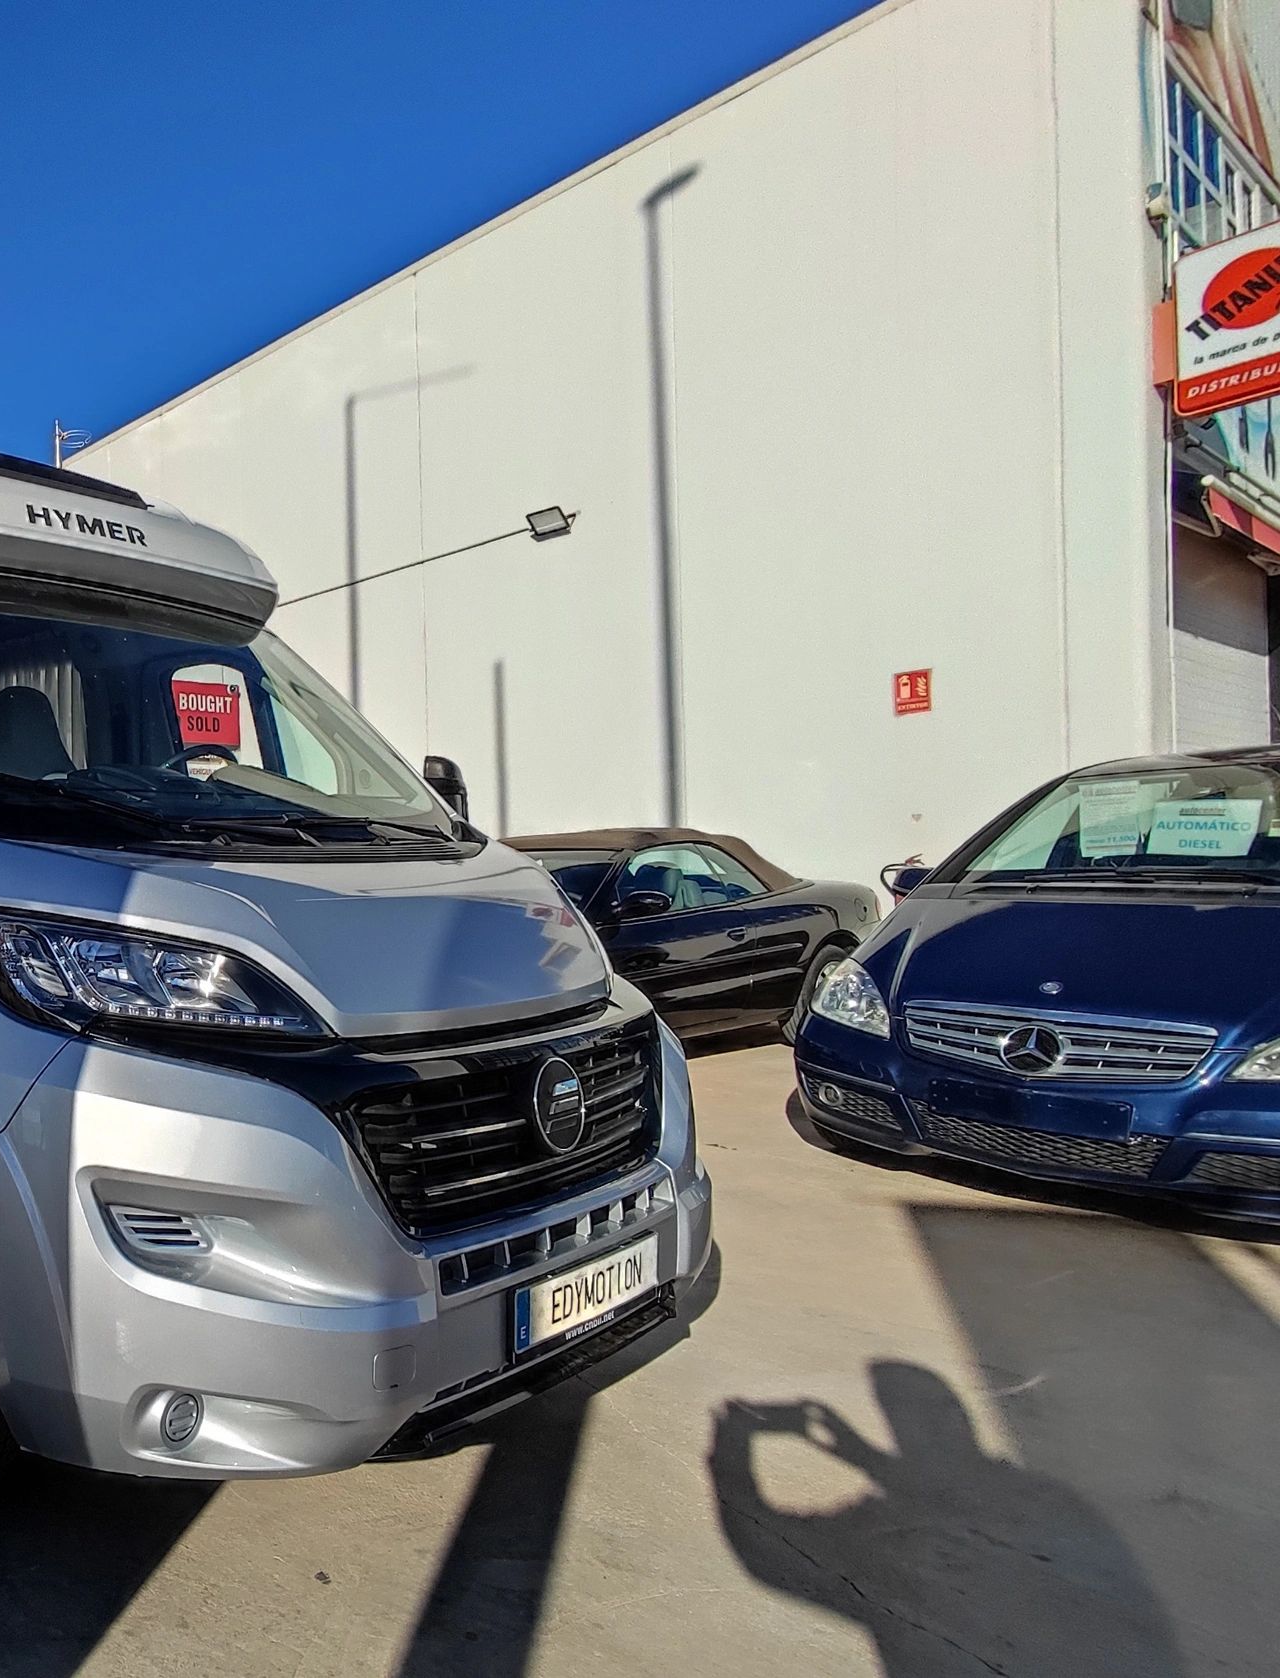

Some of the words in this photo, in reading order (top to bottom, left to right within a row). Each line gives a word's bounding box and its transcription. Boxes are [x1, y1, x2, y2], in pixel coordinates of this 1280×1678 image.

[1193, 355, 1204, 366] la
[1209, 341, 1247, 360] marca
[1252, 336, 1269, 347] de
[1187, 362, 1280, 398] DISTRIBU
[26, 504, 148, 547] HYMER
[179, 693, 232, 714] BOUGHT
[187, 715, 220, 733] SOLD
[1156, 819, 1252, 832] AUTOMÁTICO
[1178, 839, 1222, 849] DIESEL
[551, 1252, 642, 1324] EDYMOTION
[520, 1326, 527, 1339] E
